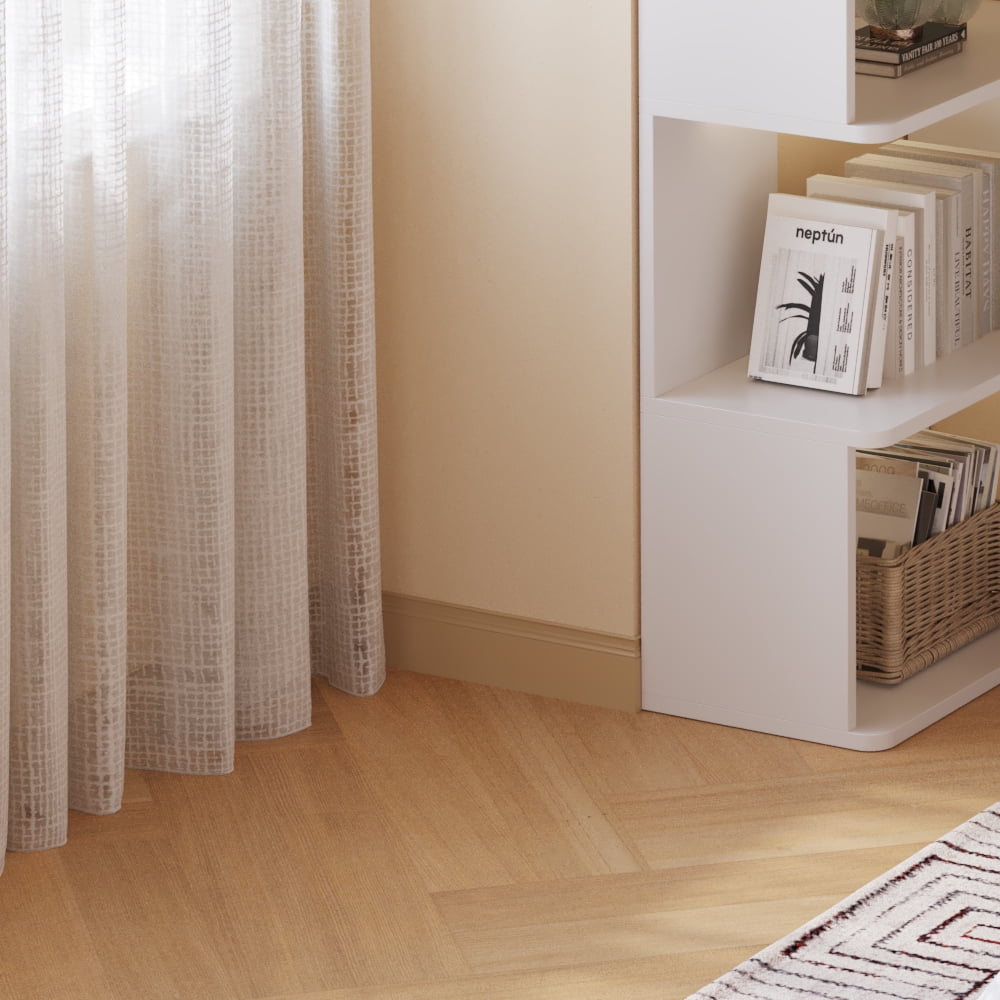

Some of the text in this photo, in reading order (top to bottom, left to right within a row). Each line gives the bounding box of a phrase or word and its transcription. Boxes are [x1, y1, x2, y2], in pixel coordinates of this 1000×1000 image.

[901, 47, 921, 63] VANITY
[921, 43, 933, 55] FAIR
[942, 32, 959, 46] YEARS
[796, 227, 844, 245] neptún
[964, 227, 973, 300] HABITAT
